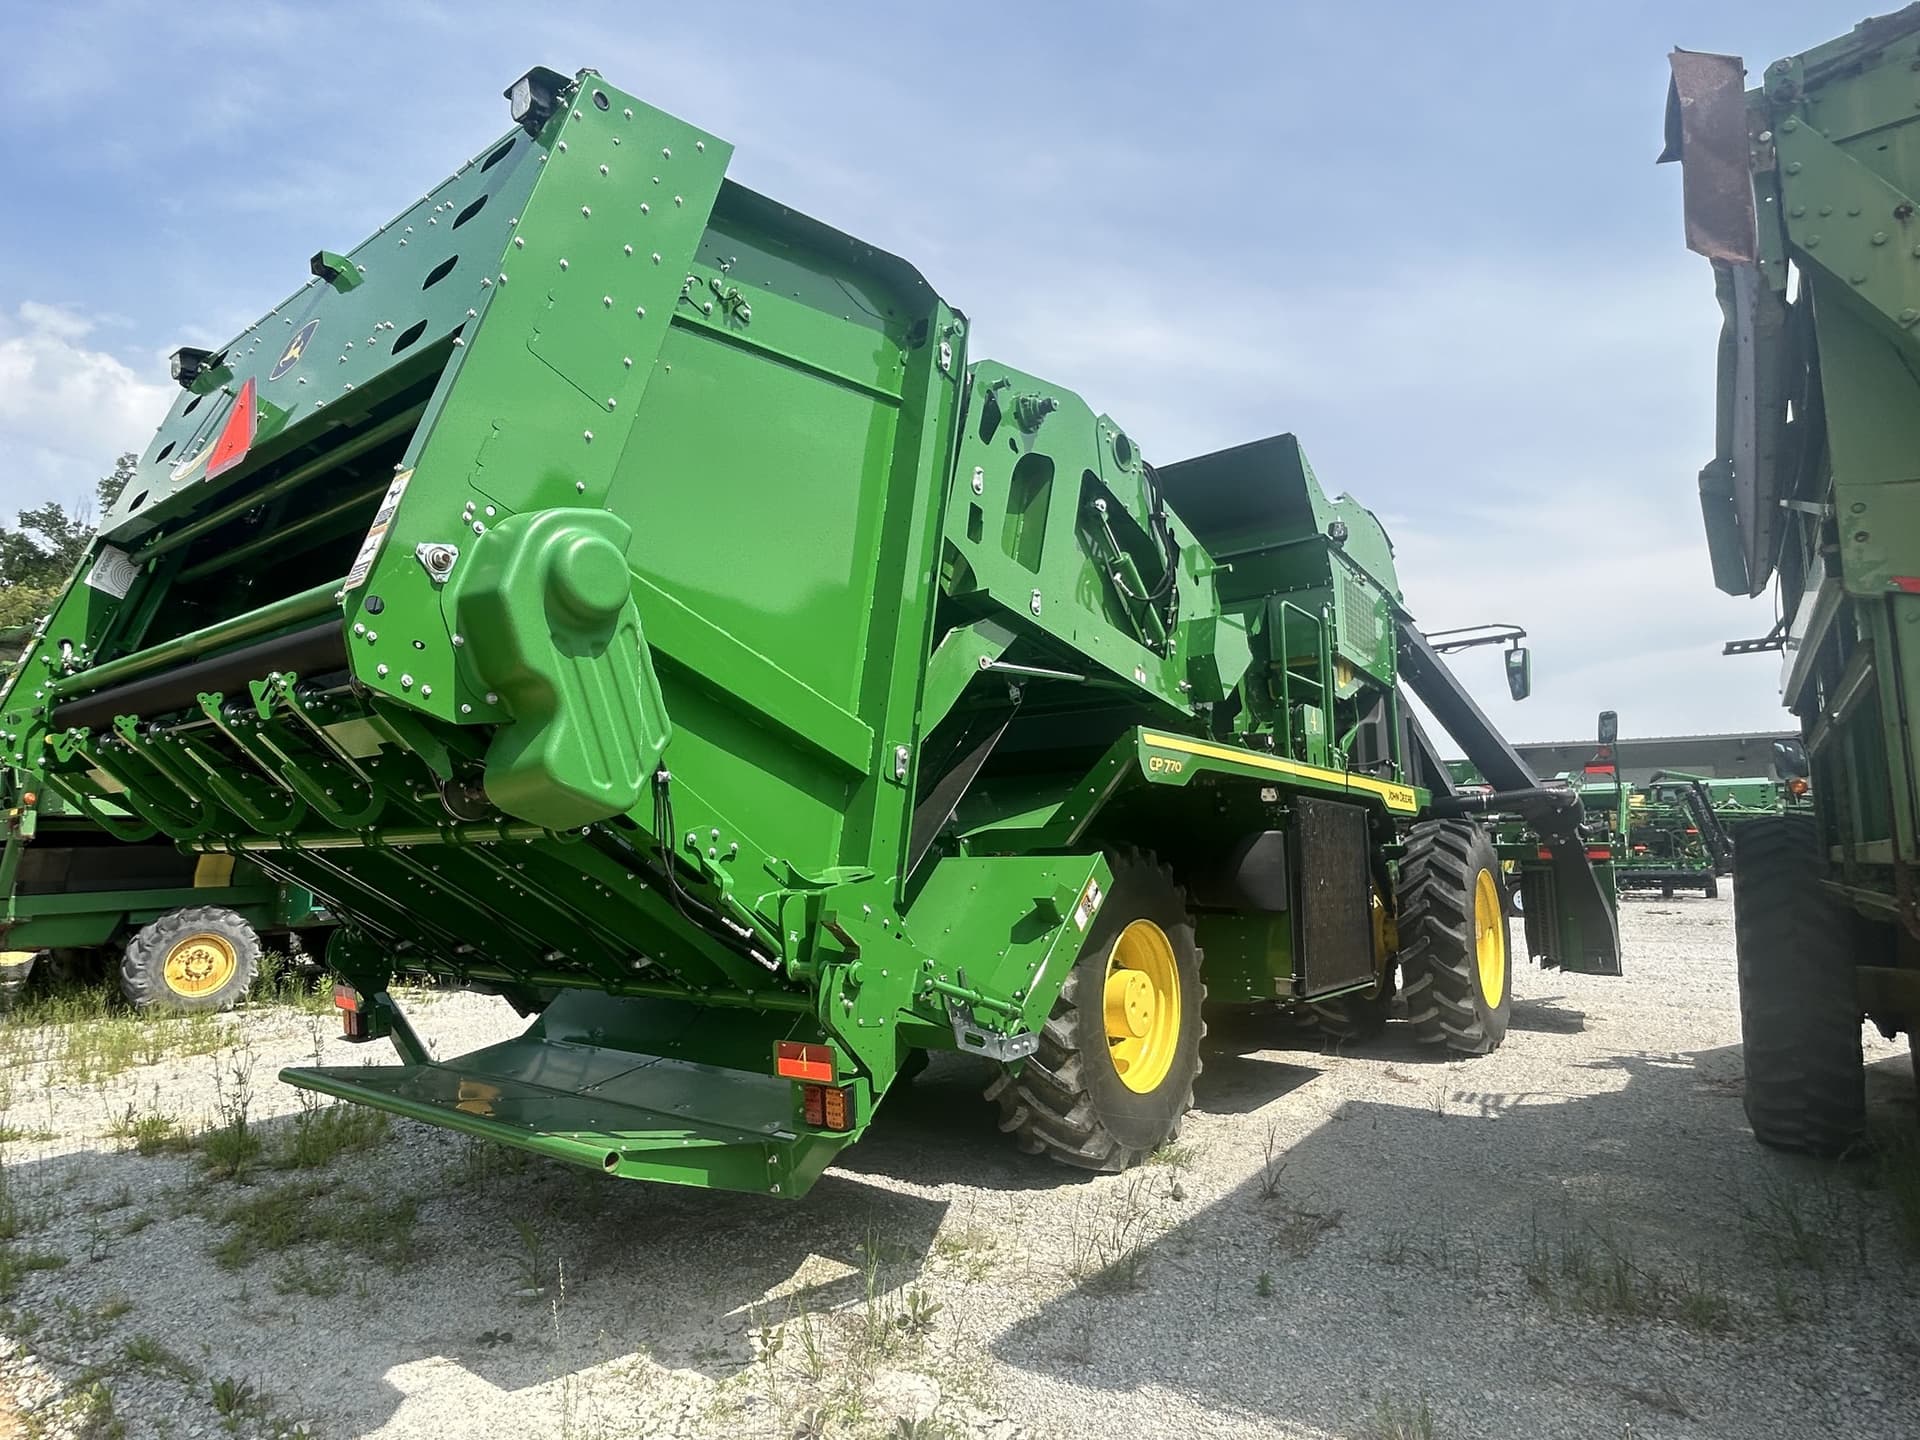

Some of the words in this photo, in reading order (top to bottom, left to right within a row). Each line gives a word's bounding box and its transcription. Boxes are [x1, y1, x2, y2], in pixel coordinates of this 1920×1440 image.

[1149, 756, 1164, 771] CP
[1164, 759, 1182, 773] 770
[1388, 789, 1400, 801] JOHN
[1400, 791, 1414, 804] DEERE
